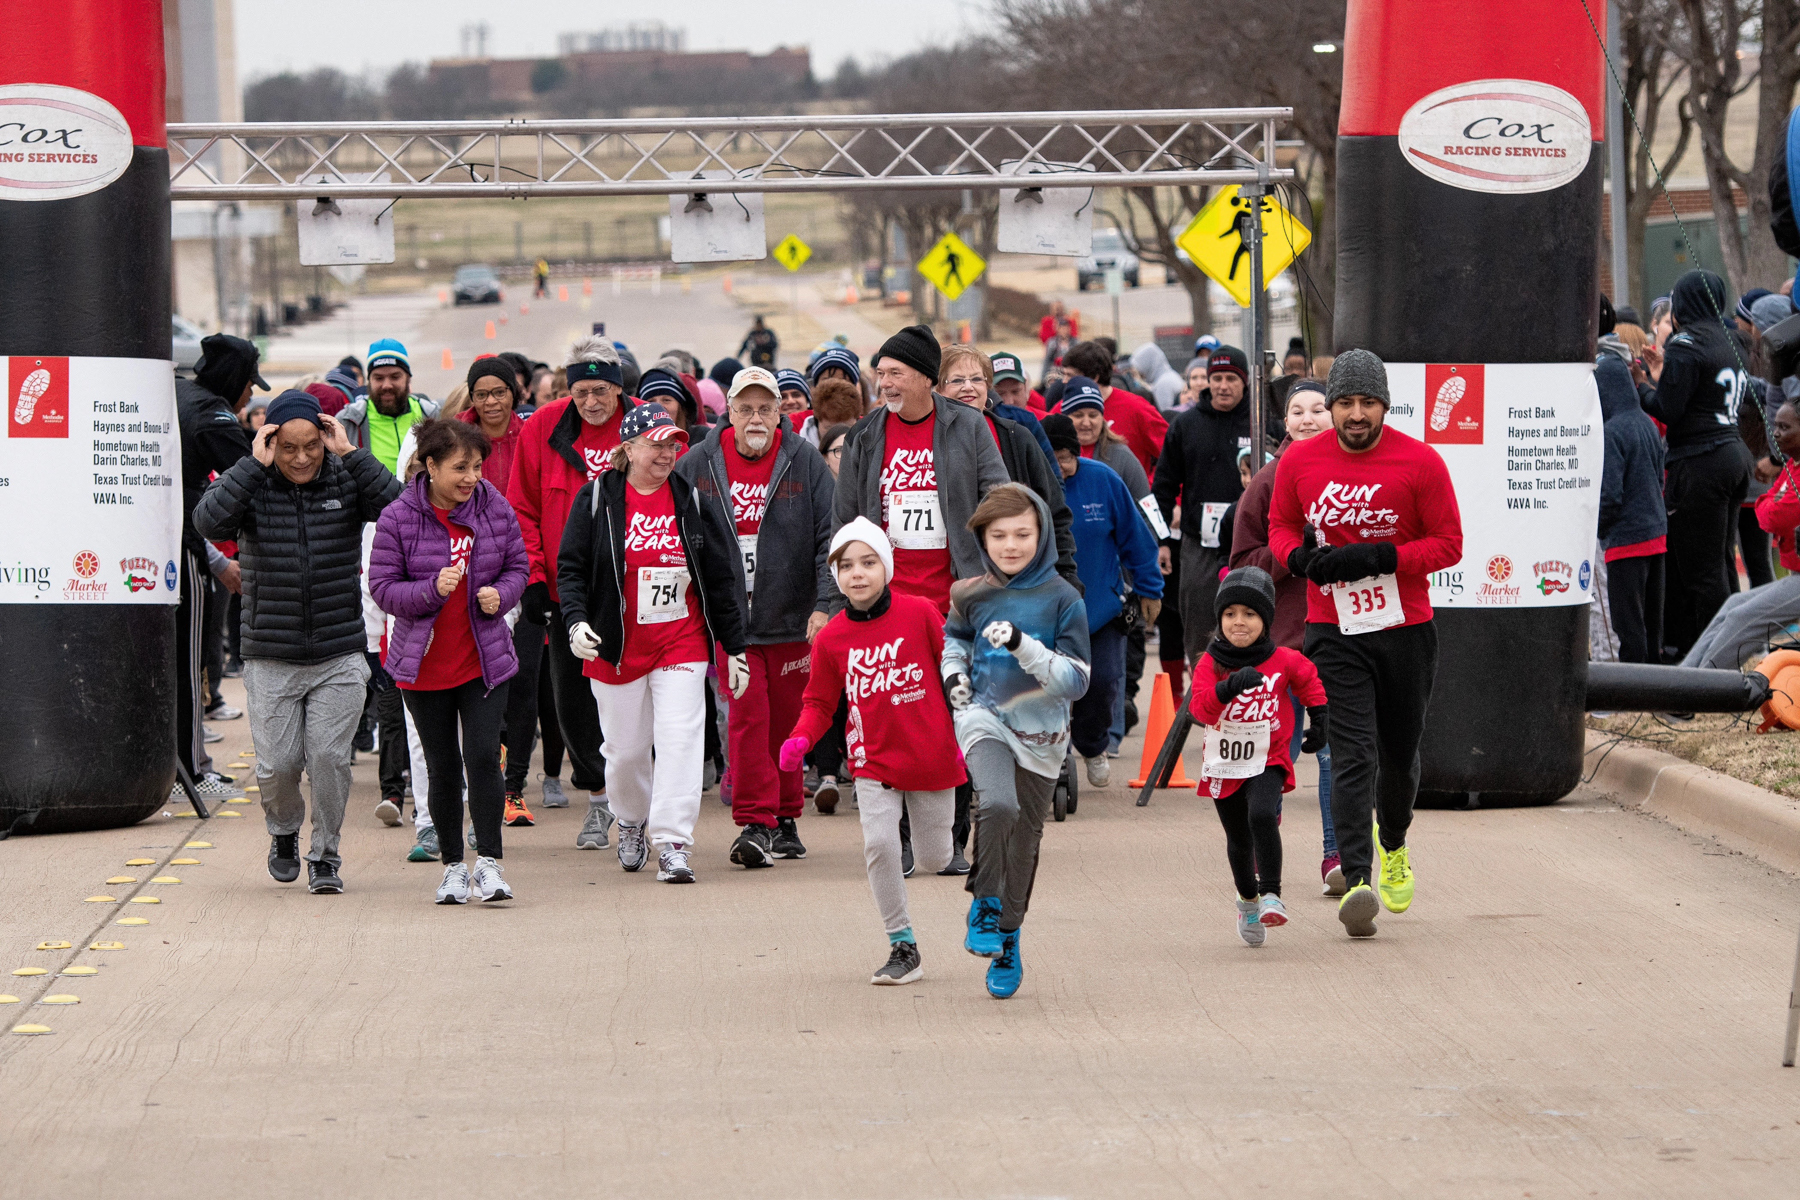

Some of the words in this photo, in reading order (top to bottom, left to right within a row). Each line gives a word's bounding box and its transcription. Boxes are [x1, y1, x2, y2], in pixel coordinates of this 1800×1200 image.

[0, 122, 83, 149] Cox
[1463, 117, 1555, 143] Cox
[28, 152, 98, 164] SERVICES
[1444, 146, 1501, 156] RACING
[1505, 146, 1567, 158] SERVICES
[93, 400, 116, 412] Frost
[119, 401, 139, 413] Bank
[1389, 403, 1415, 418] amily
[1508, 407, 1532, 418] Frost
[1535, 406, 1556, 418] Bank
[93, 420, 125, 434] Haynes
[128, 421, 142, 433] and
[143, 421, 162, 434] Boone
[1508, 426, 1541, 441] Haynes
[1543, 425, 1558, 438] and
[1560, 425, 1579, 437] Boone
[1580, 424, 1591, 437] LLP
[93, 439, 138, 452] Hometown
[140, 440, 160, 453] Health
[1507, 445, 1554, 457] Hometown
[1556, 444, 1578, 456] Health
[93, 453, 118, 466] Darin
[120, 454, 150, 467] Charles,
[151, 455, 162, 467] MD
[889, 447, 934, 473] RUN
[1507, 459, 1532, 471] Darin
[1535, 458, 1566, 471] Charles,
[1568, 457, 1579, 470] MD
[93, 473, 119, 486] Texas
[121, 473, 141, 486] Trust
[142, 473, 161, 487] Credit
[879, 467, 938, 494] HEAR
[1507, 478, 1533, 491] Texas
[1535, 477, 1556, 490] Trust
[1558, 477, 1577, 489] Credit
[93, 492, 117, 505] VAVA
[119, 493, 135, 505] Inc.
[729, 480, 769, 506] RUN
[1318, 480, 1383, 509] RUN
[1507, 497, 1531, 510] VAVA
[1533, 497, 1549, 509] Inc.
[734, 503, 765, 523] EAR
[903, 508, 935, 531] 771
[1305, 502, 1394, 529] HEART
[629, 511, 677, 537] RUN
[451, 535, 475, 560] UN
[120, 557, 159, 577] FUZZY'S
[1533, 560, 1573, 579] FUZZY'S
[63, 578, 108, 592] Market
[1476, 583, 1521, 595] Market
[63, 592, 106, 601] STREET
[651, 582, 678, 606] 754
[1348, 585, 1387, 615] 335
[1477, 595, 1519, 605] STREET
[847, 637, 905, 677] RUN
[879, 660, 896, 670] with
[845, 662, 918, 704] HEART
[1255, 692, 1271, 700] with
[1219, 738, 1255, 761] 800
